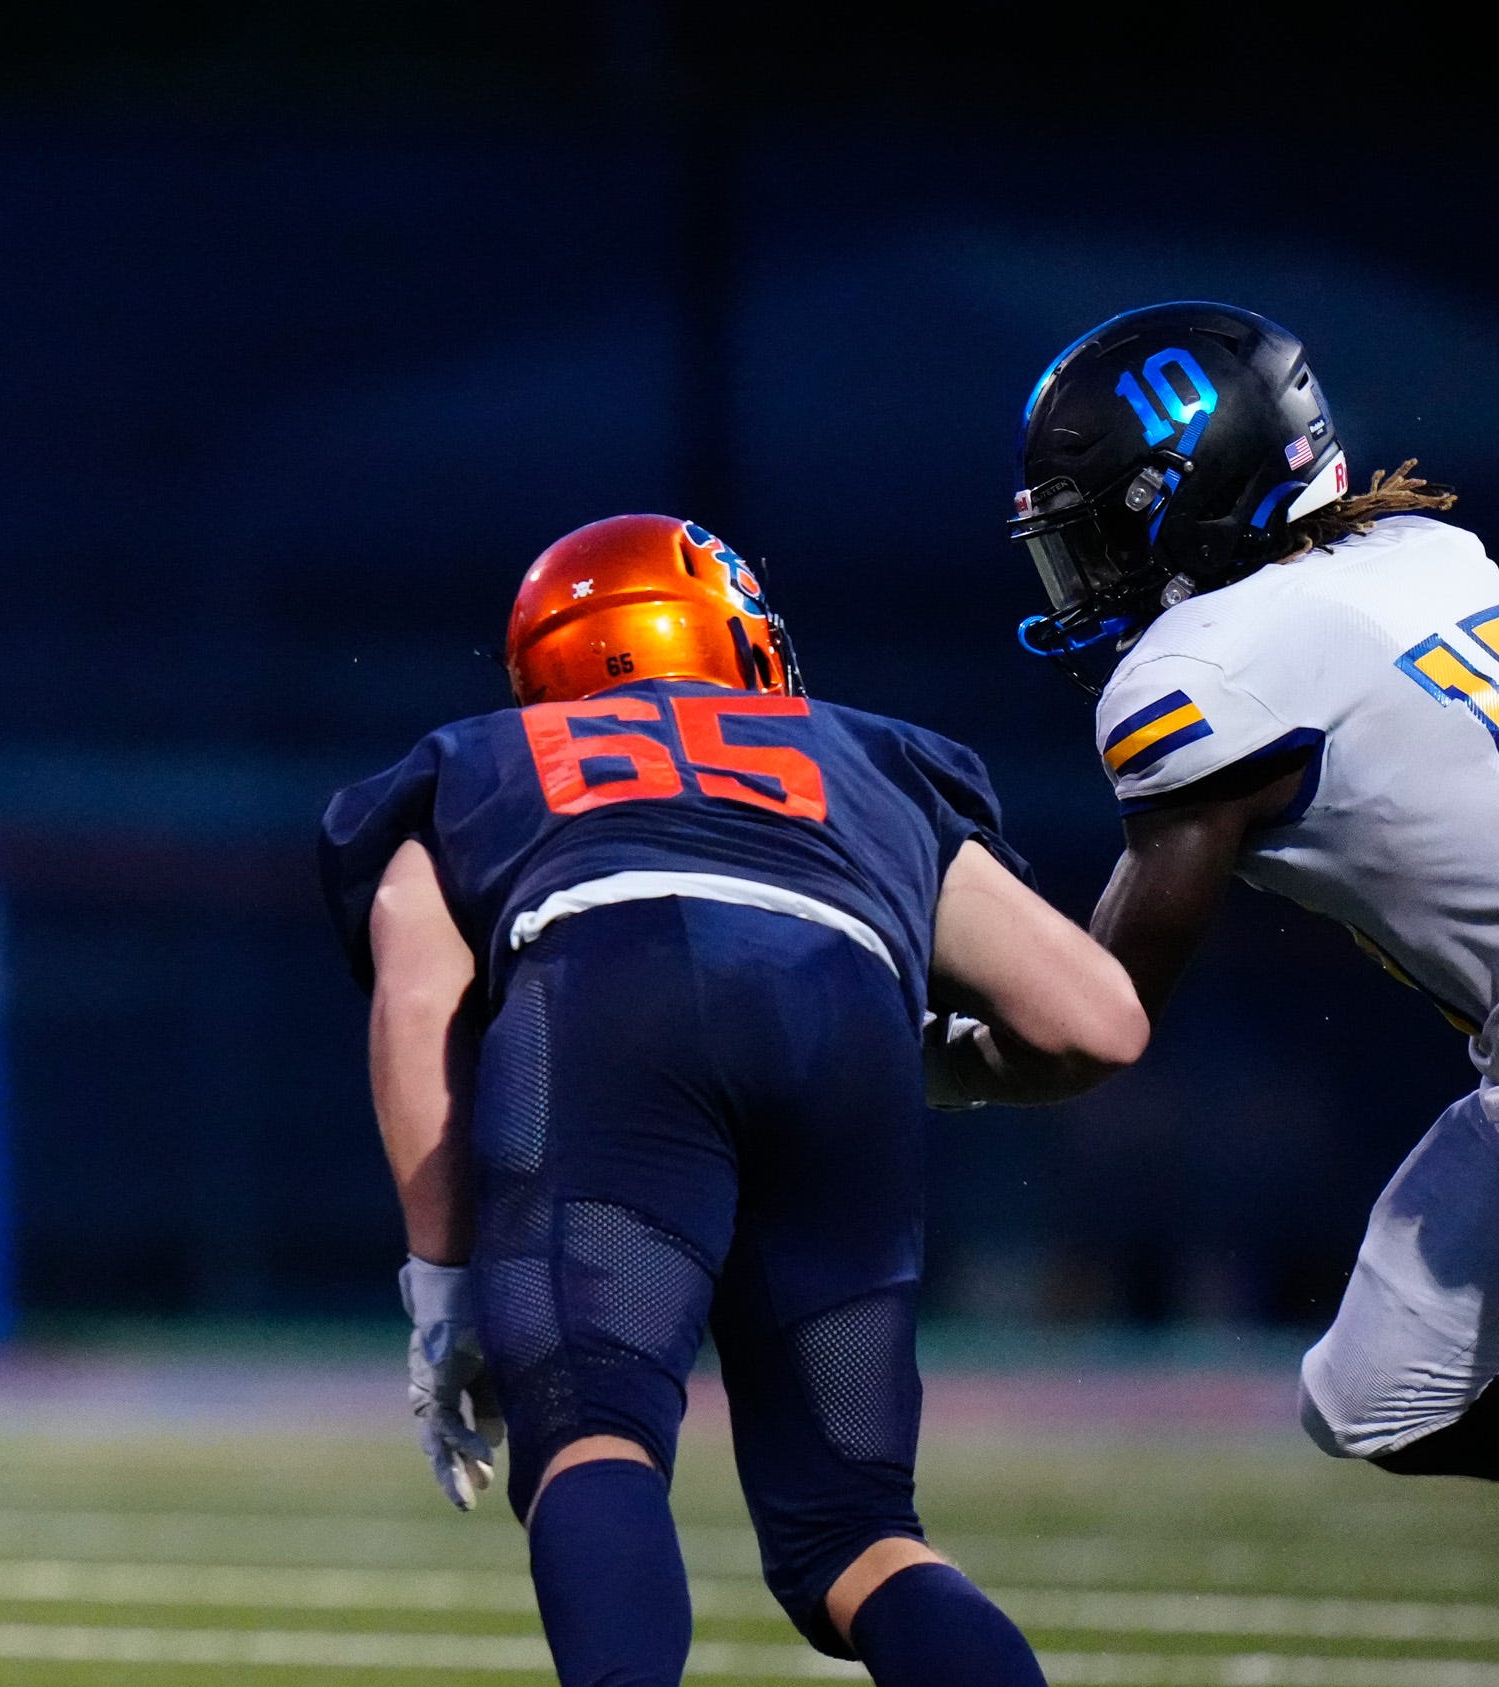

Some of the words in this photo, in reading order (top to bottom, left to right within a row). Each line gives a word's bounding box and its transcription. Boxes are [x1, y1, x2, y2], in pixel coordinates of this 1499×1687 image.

[1114, 347, 1219, 446] 10
[606, 652, 635, 678] 65
[521, 696, 828, 822] 65
